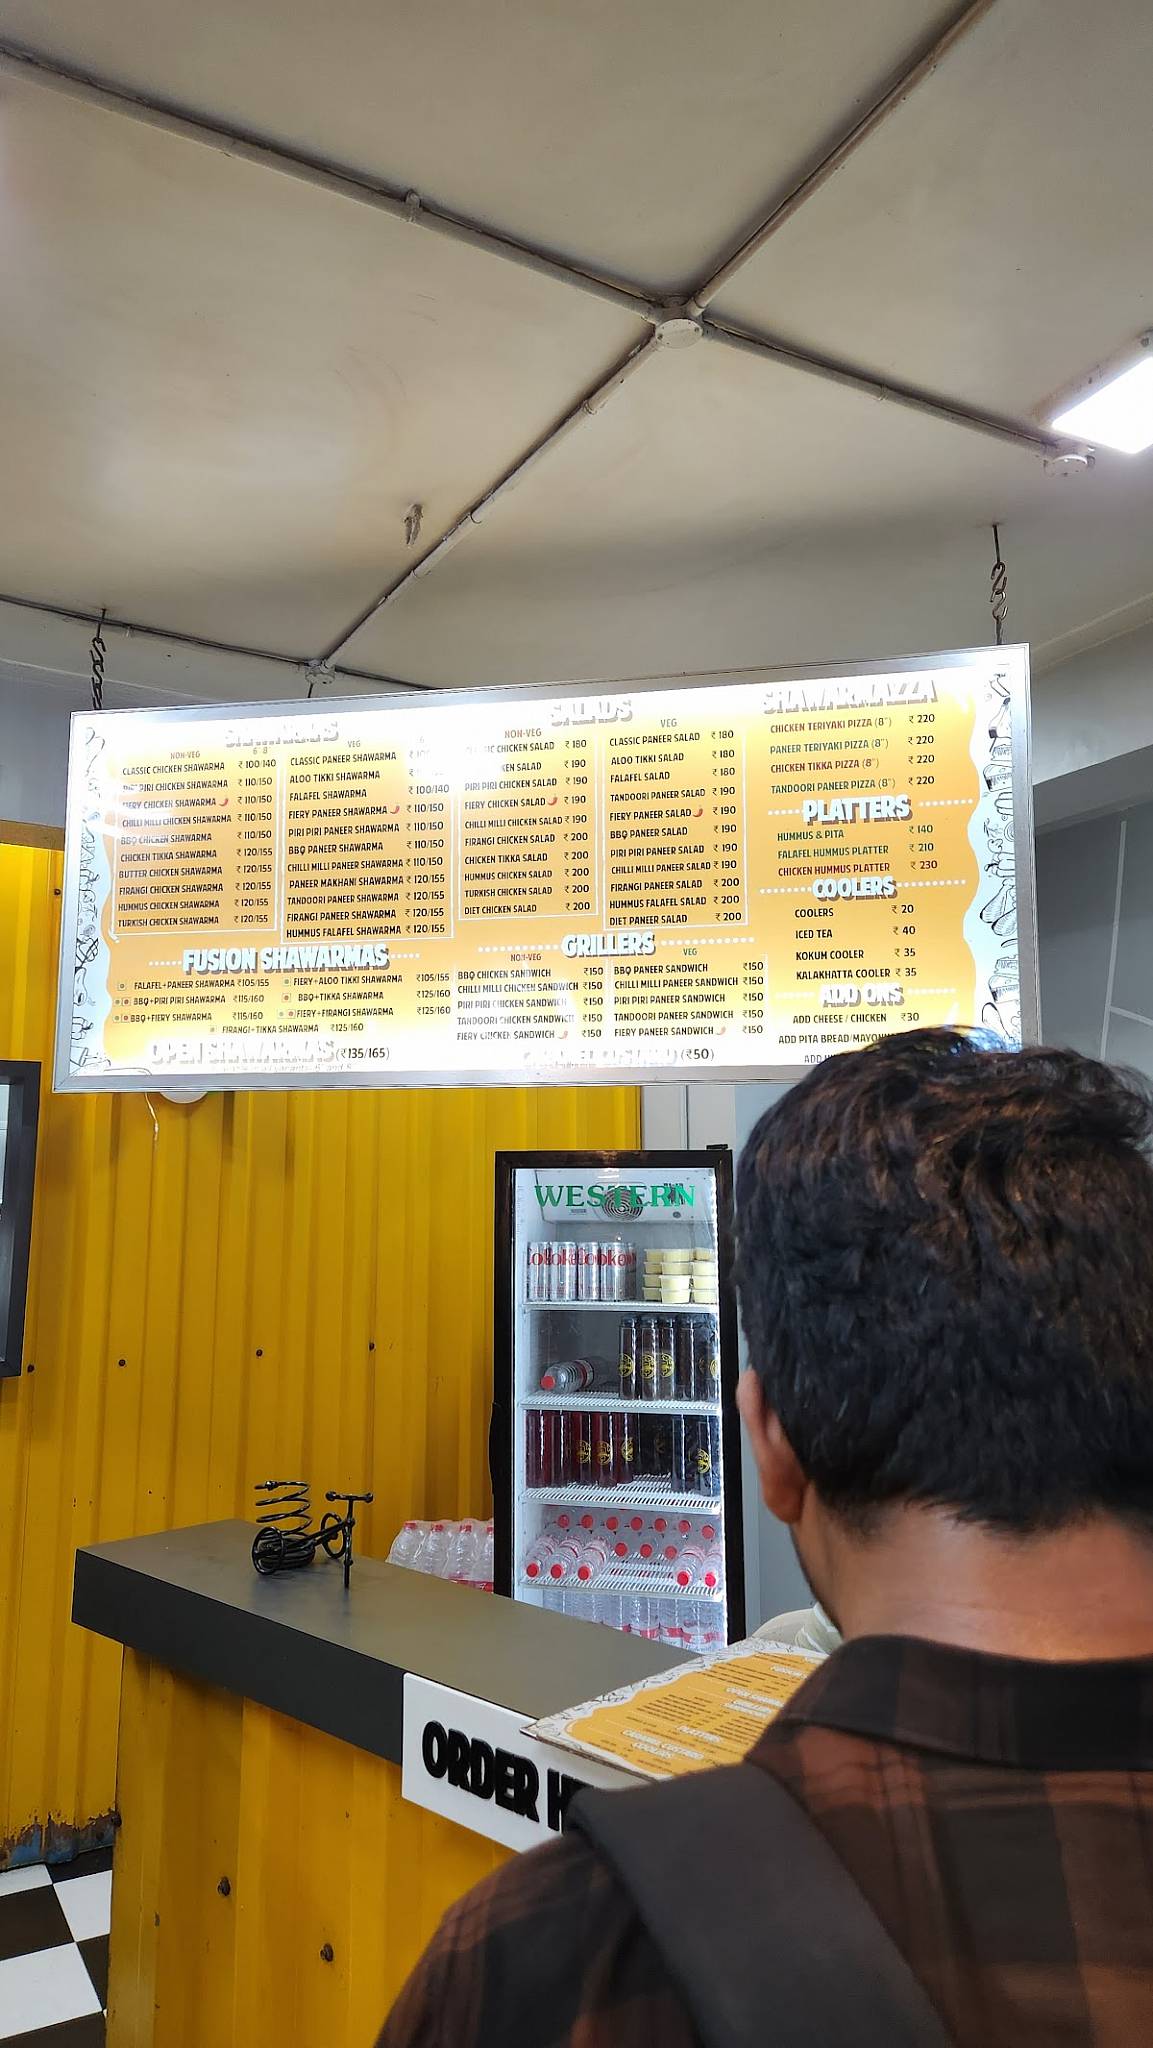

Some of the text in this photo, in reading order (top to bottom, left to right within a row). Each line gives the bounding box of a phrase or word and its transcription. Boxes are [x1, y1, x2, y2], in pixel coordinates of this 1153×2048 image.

[661, 719, 677, 728] VEG
[771, 722, 805, 733] CHICKEN
[808, 721, 845, 732] TERIYAKI
[848, 720, 872, 730] PIZZA
[505, 728, 541, 738] NON-VEG
[348, 740, 361, 748] VEG
[610, 737, 640, 746] CLASSIC
[643, 735, 672, 744] PANEER
[674, 733, 700, 742] SALAD
[771, 744, 801, 754] PANEER
[804, 742, 842, 752] TERIYAKI
[845, 740, 869, 750] PIZZA
[170, 751, 200, 759] NON-VEG
[291, 752, 396, 766] CLASSIC PANEER SHAWARMA
[612, 753, 684, 765] ALOO TIKKI SALAD
[123, 763, 224, 775] CLASSIC CHICKEN SHAWARMA
[771, 762, 805, 773] CHICKEN
[808, 761, 832, 771] TIKKA
[835, 760, 859, 770] PIZZA
[290, 771, 380, 783] ALOO TIKKI SHAWARMA
[611, 772, 669, 782] FALAFEL SALAD
[772, 782, 814, 794] TANDOORI
[818, 781, 848, 791] PANEER
[851, 780, 875, 790] PIZZA
[290, 789, 366, 801] FALAFEL SHAWARMA
[611, 789, 705, 802] TANDOORI PANEER SALAD
[289, 810, 309, 819] FIERY
[312, 808, 341, 818] PANEER
[344, 806, 387, 816] SHAWARMA
[610, 809, 691, 821] FIERY PANEER SALAD
[803, 794, 913, 826] PLATTERS
[611, 827, 687, 839] BBQ PANEER SALAD
[778, 831, 813, 841] HUMMUS
[817, 831, 822, 840] &
[825, 830, 844, 840] PITA
[465, 837, 494, 846] FIRANGI
[497, 836, 528, 844] CHICKEN
[530, 834, 555, 843] SALAD
[289, 846, 305, 854] BBQ
[308, 844, 336, 853] PANEER
[339, 842, 382, 852] SHAWARMA
[778, 849, 811, 859] FALAFEL
[814, 847, 849, 858] HUMMUS
[852, 846, 888, 856] PLATTER
[121, 853, 150, 862] CHICKEN
[153, 852, 173, 860] TIKKA
[176, 850, 216, 859] SHAWARMA
[465, 854, 547, 864] CHICKEN TIKKA SALAD
[119, 870, 147, 878] BUTTER
[150, 868, 179, 877] CHICKEN
[181, 866, 222, 876] SHAWARMA
[612, 862, 710, 874] CHILLI MILLI PANEER SALAD
[779, 866, 812, 876] CHICKEN
[815, 865, 851, 875] HUMMUS
[854, 863, 889, 873] PLATTER
[290, 879, 318, 888] PANEER
[321, 878, 356, 887] MAKHANI
[359, 876, 403, 886] SHAWARMA
[611, 880, 702, 892] FIRANGI PANEER SALAD
[465, 887, 552, 897] TURKISH CHICKEN SALAD
[812, 876, 897, 901] COOLERS
[465, 906, 479, 914] DIET
[482, 906, 511, 914] CHICKEN
[514, 905, 536, 913] SALAD
[795, 908, 833, 918] COOLERS
[796, 930, 813, 939] ICED
[817, 929, 832, 938] TEA
[562, 931, 656, 958] GRILLERS
[183, 943, 390, 975] FUSION SHAWARMAS
[796, 950, 864, 961] KOKUM COOLER
[614, 966, 631, 975] BBQ
[634, 965, 663, 974] PANEER
[666, 964, 707, 973] SANDWICH
[856, 969, 890, 978] COOLER
[615, 980, 638, 989] CHILLI
[641, 980, 660, 988] MILLI
[663, 979, 693, 988] PANEER
[695, 977, 738, 987] SANDWICH
[342, 992, 383, 1001] SHAWARMA
[615, 1012, 655, 1021] TANDOORI
[658, 1012, 687, 1020] PANEER
[690, 1011, 733, 1019] SANDWICH
[793, 1015, 810, 1024] ADD
[814, 1014, 843, 1024] CHEESE
[851, 1013, 886, 1023] CHICKEN
[535, 1185, 695, 1208] WESTERN
[421, 1720, 539, 1822] ORDER
